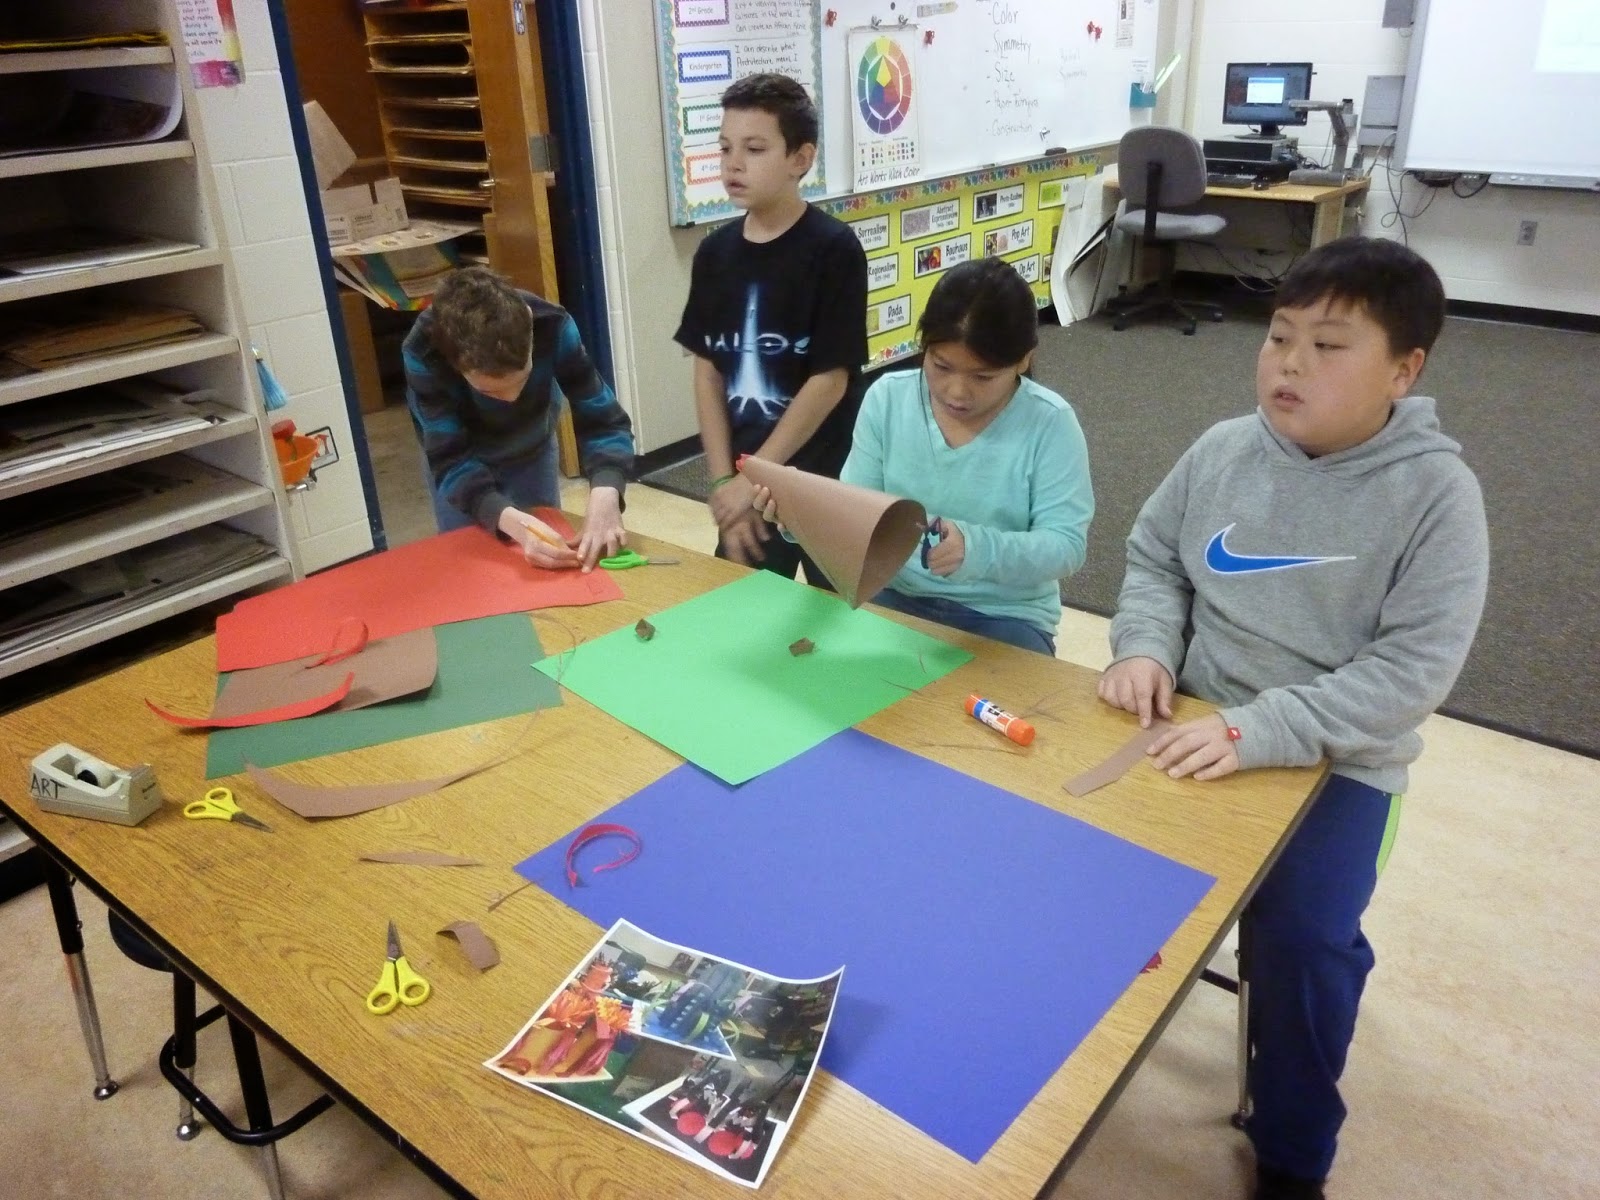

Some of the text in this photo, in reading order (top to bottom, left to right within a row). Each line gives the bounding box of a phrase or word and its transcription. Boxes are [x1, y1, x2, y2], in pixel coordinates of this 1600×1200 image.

[698, 7, 713, 15] Grade
[992, 1, 1019, 26] Color
[689, 61, 723, 71] Kindergarten
[994, 60, 1016, 83] Size
[709, 163, 721, 172] Gra
[857, 166, 920, 186] Art Works With Color
[857, 223, 887, 239] Surrealism
[1011, 228, 1021, 241] Pop
[1021, 225, 1030, 238] Art
[945, 242, 968, 257] Bauhaus
[868, 262, 896, 277] Regionalism
[1027, 260, 1035, 273] Art
[887, 304, 903, 318] Dada
[30, 772, 68, 800] ART
